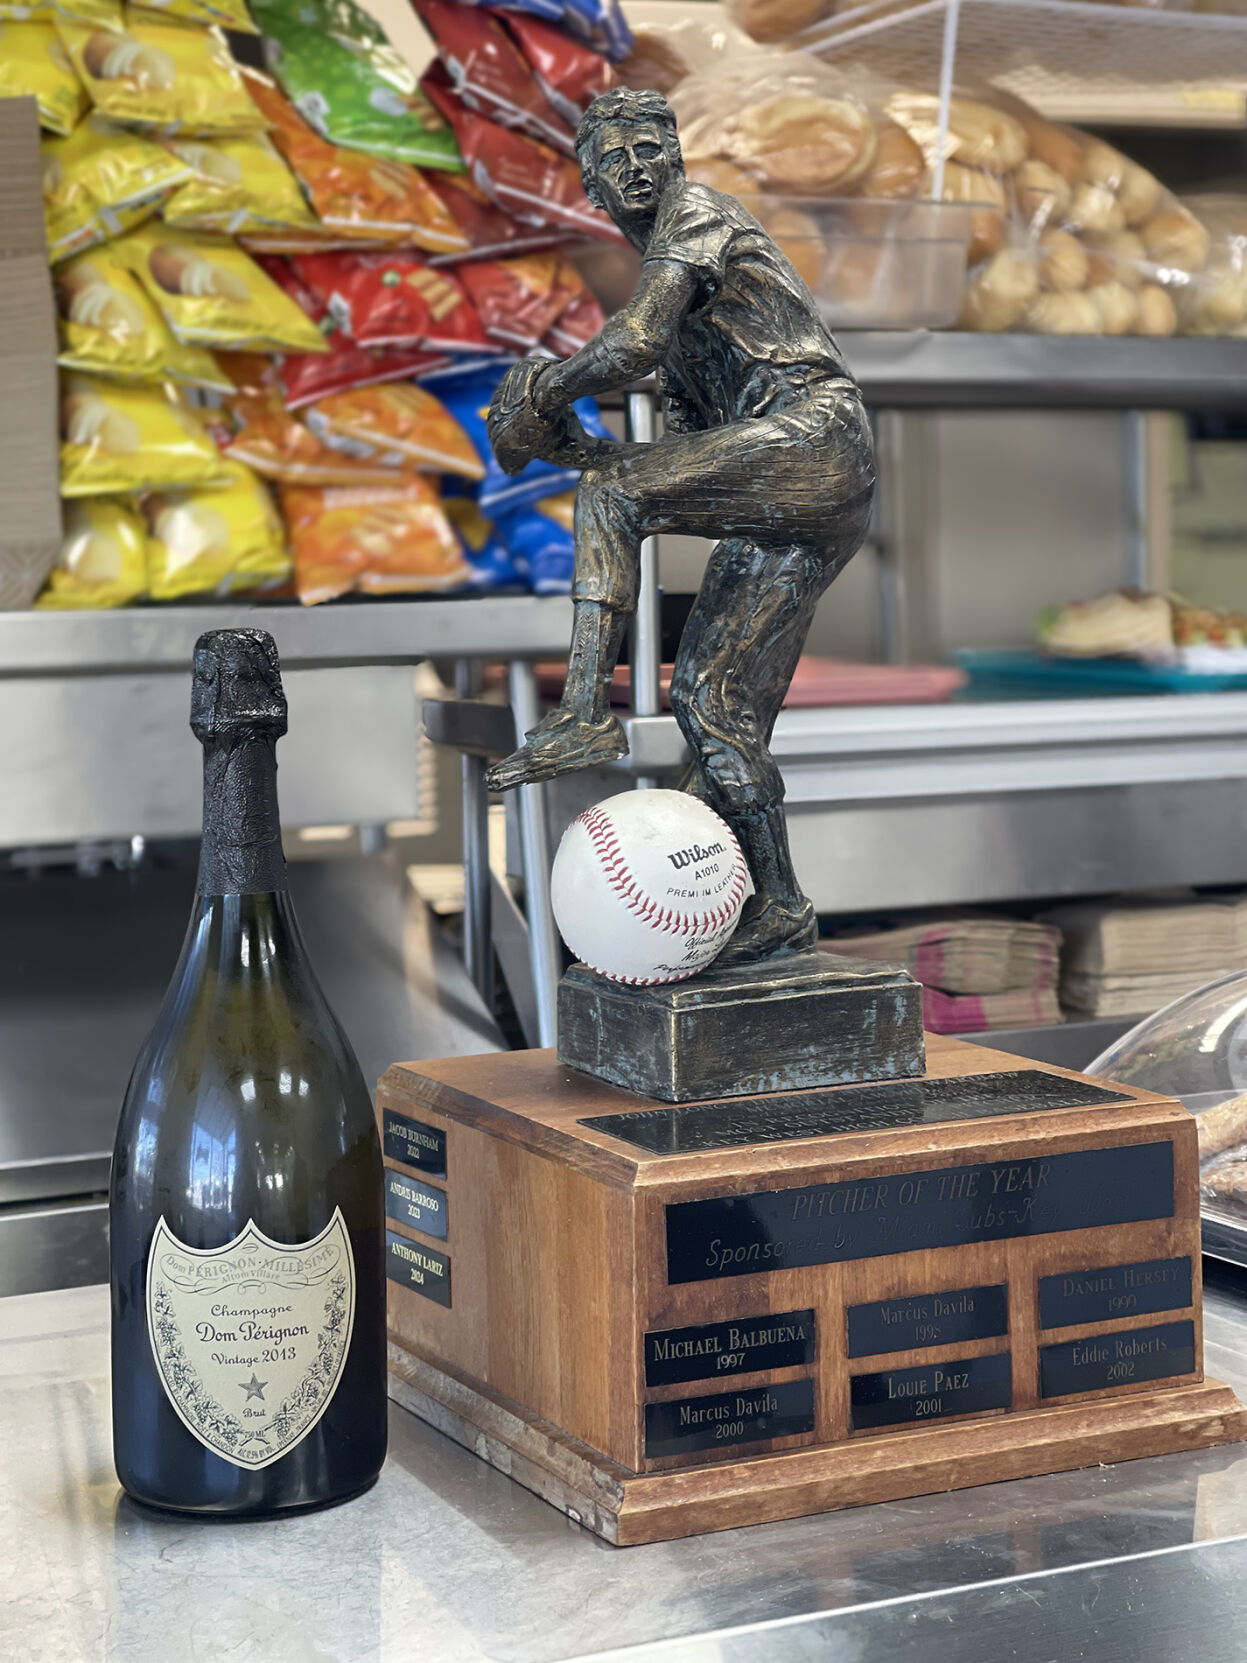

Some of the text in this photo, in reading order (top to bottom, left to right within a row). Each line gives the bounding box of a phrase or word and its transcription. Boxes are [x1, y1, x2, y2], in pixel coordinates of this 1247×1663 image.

[667, 842, 723, 869] Wilson
[695, 863, 719, 880] A1010
[792, 1164, 1050, 1221] PITCHER OF THE YEAR
[391, 1242, 423, 1266] ANTHONY
[166, 1256, 186, 1273] Dom
[1063, 1267, 1180, 1297] DANIEL HERSEY
[210, 1304, 293, 1319] Champagne
[880, 1295, 975, 1325] Marcus Davila
[1108, 1294, 1137, 1312] 1999
[195, 1321, 309, 1345] Dom Pérignon
[654, 1325, 806, 1361] MICHAEL BALBUENA
[211, 1346, 296, 1367] Vintage 2013
[716, 1353, 746, 1369] 1997
[1072, 1337, 1167, 1366] Eddie Roberts
[1107, 1360, 1135, 1380] 2002
[888, 1371, 969, 1399] LOUIE PAEZ
[242, 1407, 266, 1418] Brut
[680, 1393, 778, 1426] Marcus Davila
[915, 1398, 942, 1416] 2001
[244, 1430, 265, 1439] 750 ML
[715, 1421, 744, 1439] 2000
[209, 1435, 234, 1455] CHANDON
